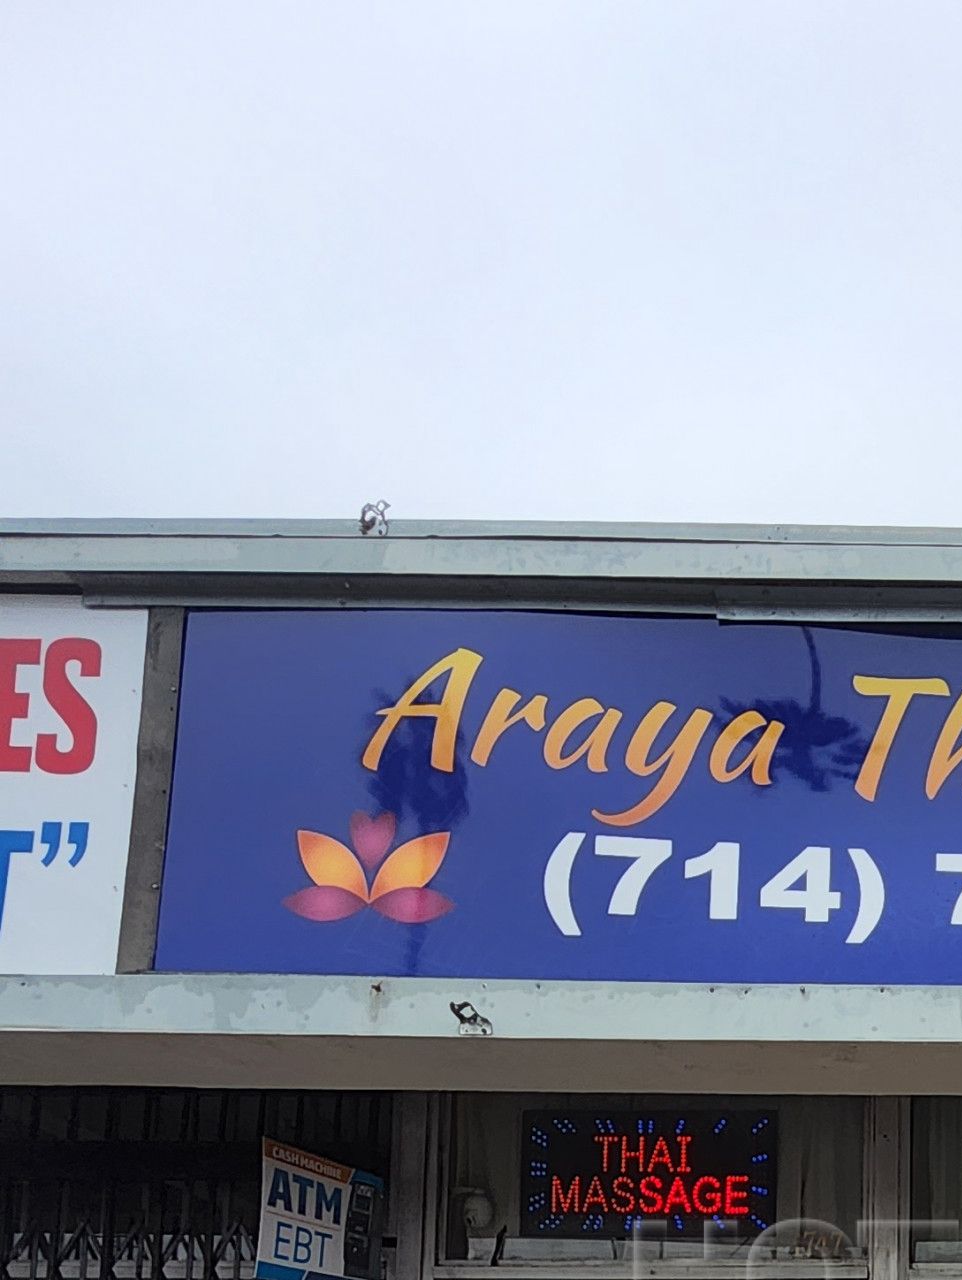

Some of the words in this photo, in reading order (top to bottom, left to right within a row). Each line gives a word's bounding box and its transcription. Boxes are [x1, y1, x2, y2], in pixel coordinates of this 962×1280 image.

[0, 637, 101, 775] ES
[362, 647, 785, 827] Araya
[542, 832, 885, 944] (714)
[272, 1147, 300, 1164] CASH
[300, 1155, 342, 1179] MACHINE
[594, 1135, 692, 1172] THAI
[267, 1168, 342, 1225] ATM
[551, 1175, 749, 1214] MASSAGE
[274, 1221, 333, 1268] EBT
